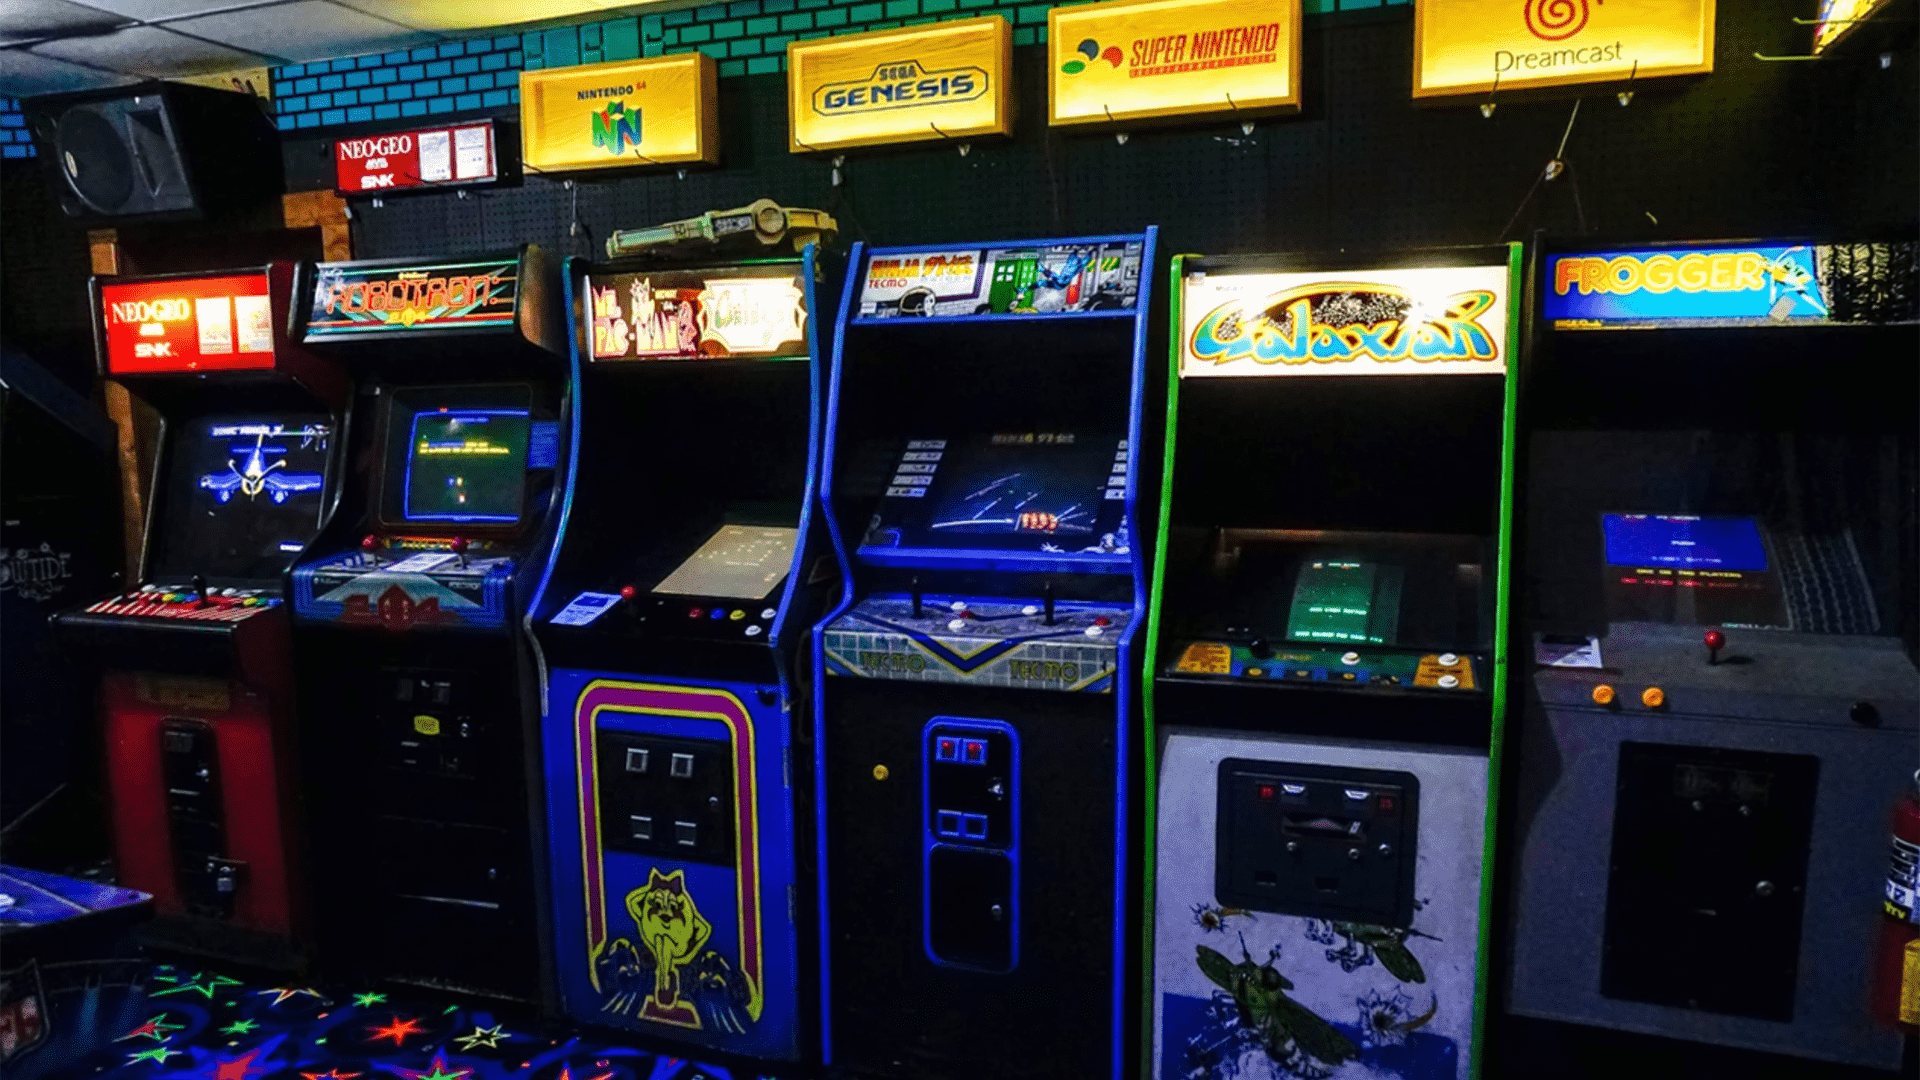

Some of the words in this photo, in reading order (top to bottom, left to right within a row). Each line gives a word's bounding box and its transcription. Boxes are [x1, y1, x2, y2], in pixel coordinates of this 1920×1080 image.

[1130, 35, 1187, 67] SUPER
[1191, 22, 1279, 60] NINTENDO
[1495, 41, 1622, 73] Dreamcast
[879, 65, 917, 81] SEGA
[577, 85, 634, 101] NINTENDO
[824, 73, 974, 109] GENESIS
[361, 173, 394, 189] SNK
[868, 278, 908, 289] TECMO
[1554, 253, 1765, 296] FROGGER
[134, 342, 171, 357] SNK
[859, 651, 926, 674] TECMO
[1010, 659, 1079, 683] TECMO
